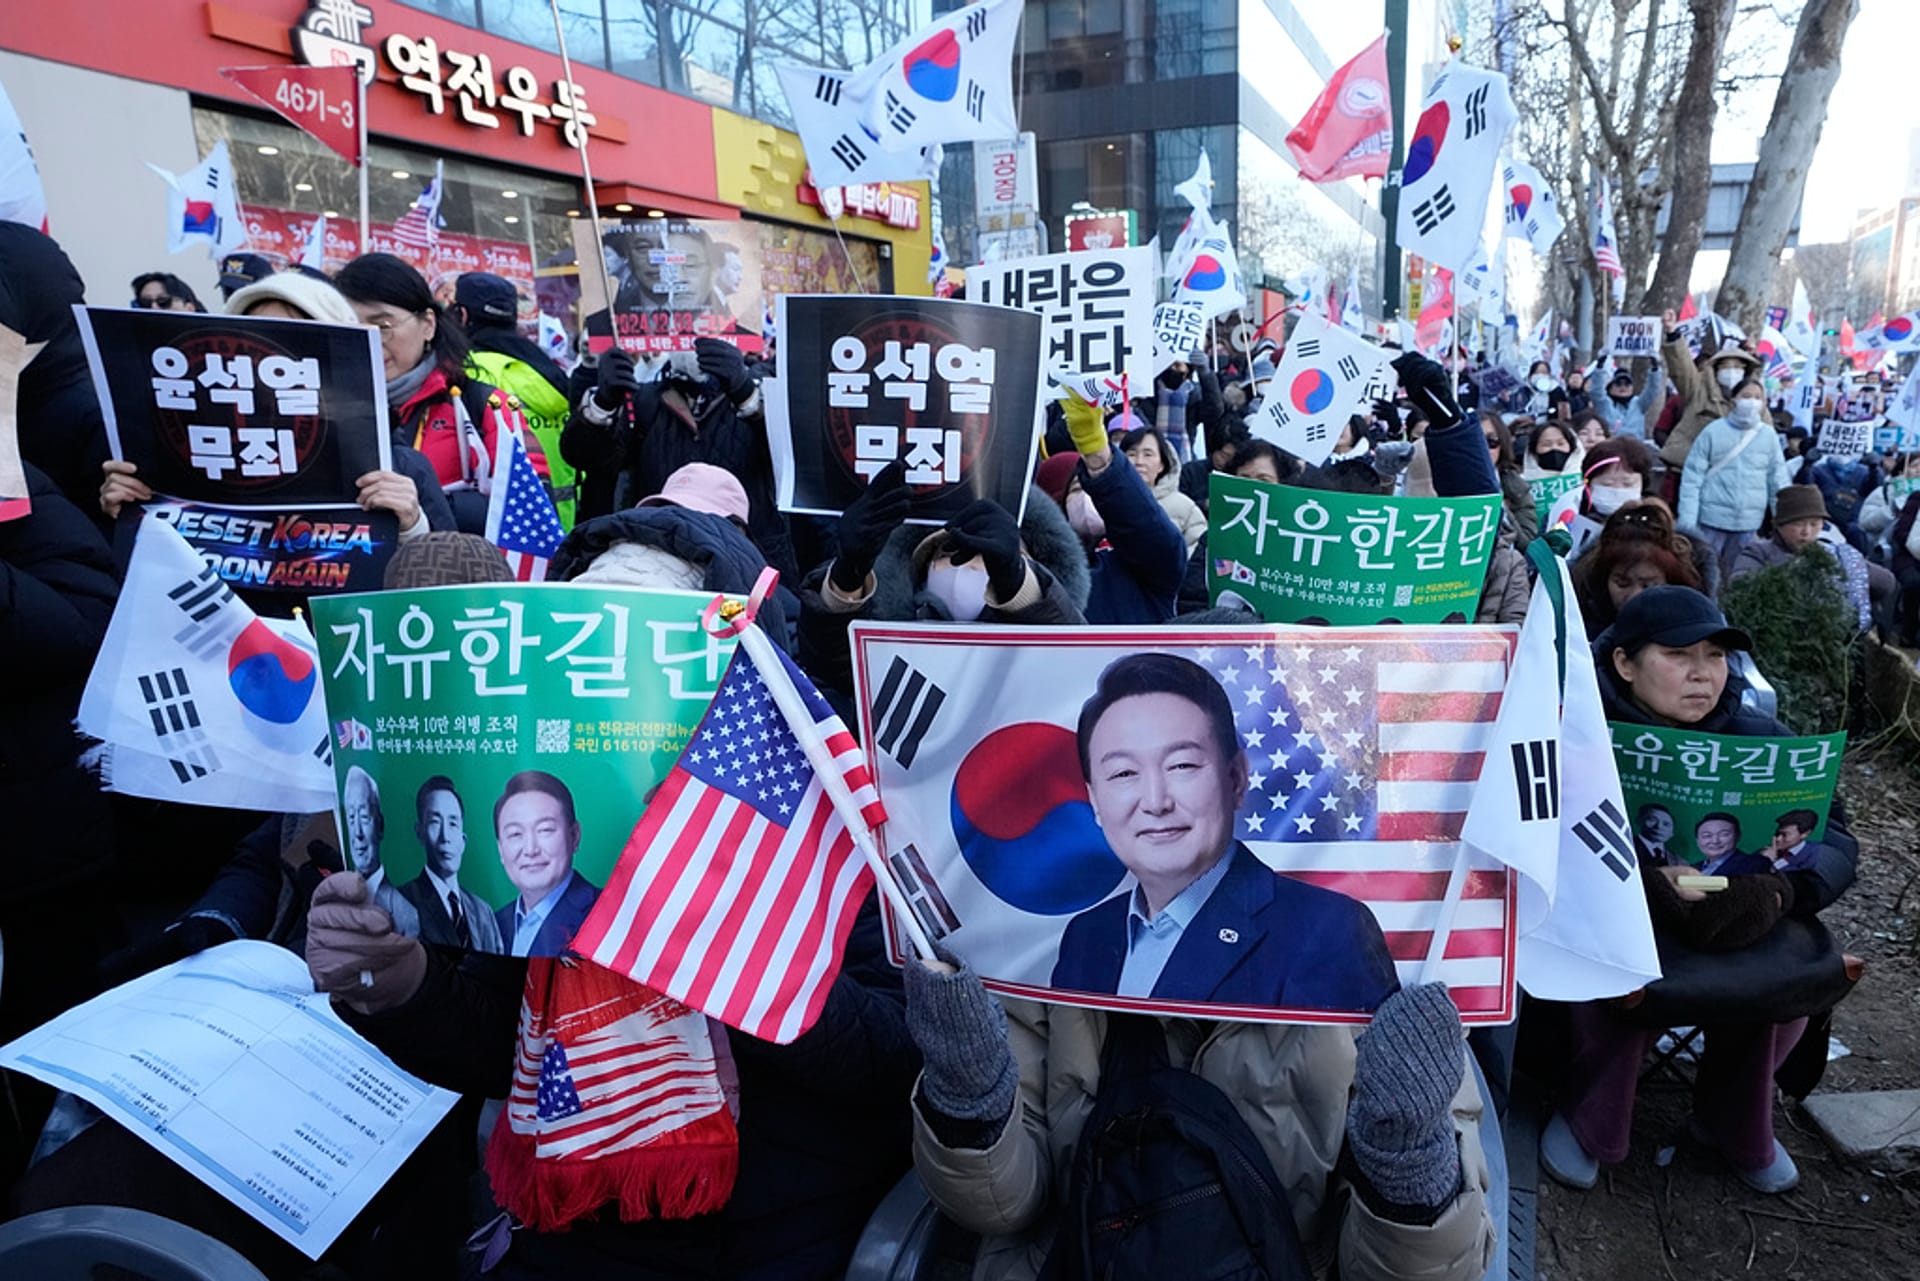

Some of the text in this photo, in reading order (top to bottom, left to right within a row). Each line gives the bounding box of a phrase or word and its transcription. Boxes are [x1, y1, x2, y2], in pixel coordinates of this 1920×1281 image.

[275, 78, 355, 128] 46기-3
[386, 33, 597, 148] 역전우동
[1615, 336, 1655, 350] AGAIN
[1620, 322, 1654, 336] YOON
[151, 346, 321, 415] 윤석열
[827, 335, 996, 414] 윤석열
[187, 424, 298, 480] 무죄
[854, 425, 962, 485] 무죄
[269, 515, 373, 555] KOREA
[1220, 489, 1494, 570] 자유한길단
[198, 548, 350, 588] OON AGAIN
[1309, 577, 1333, 591] 10만
[1364, 582, 1386, 595] 조직
[330, 600, 736, 700] 자유한길단
[376, 714, 517, 734] 보수우파 10만 의병 조직
[480, 738, 518, 754] 수호단
[574, 738, 598, 753] 국민
